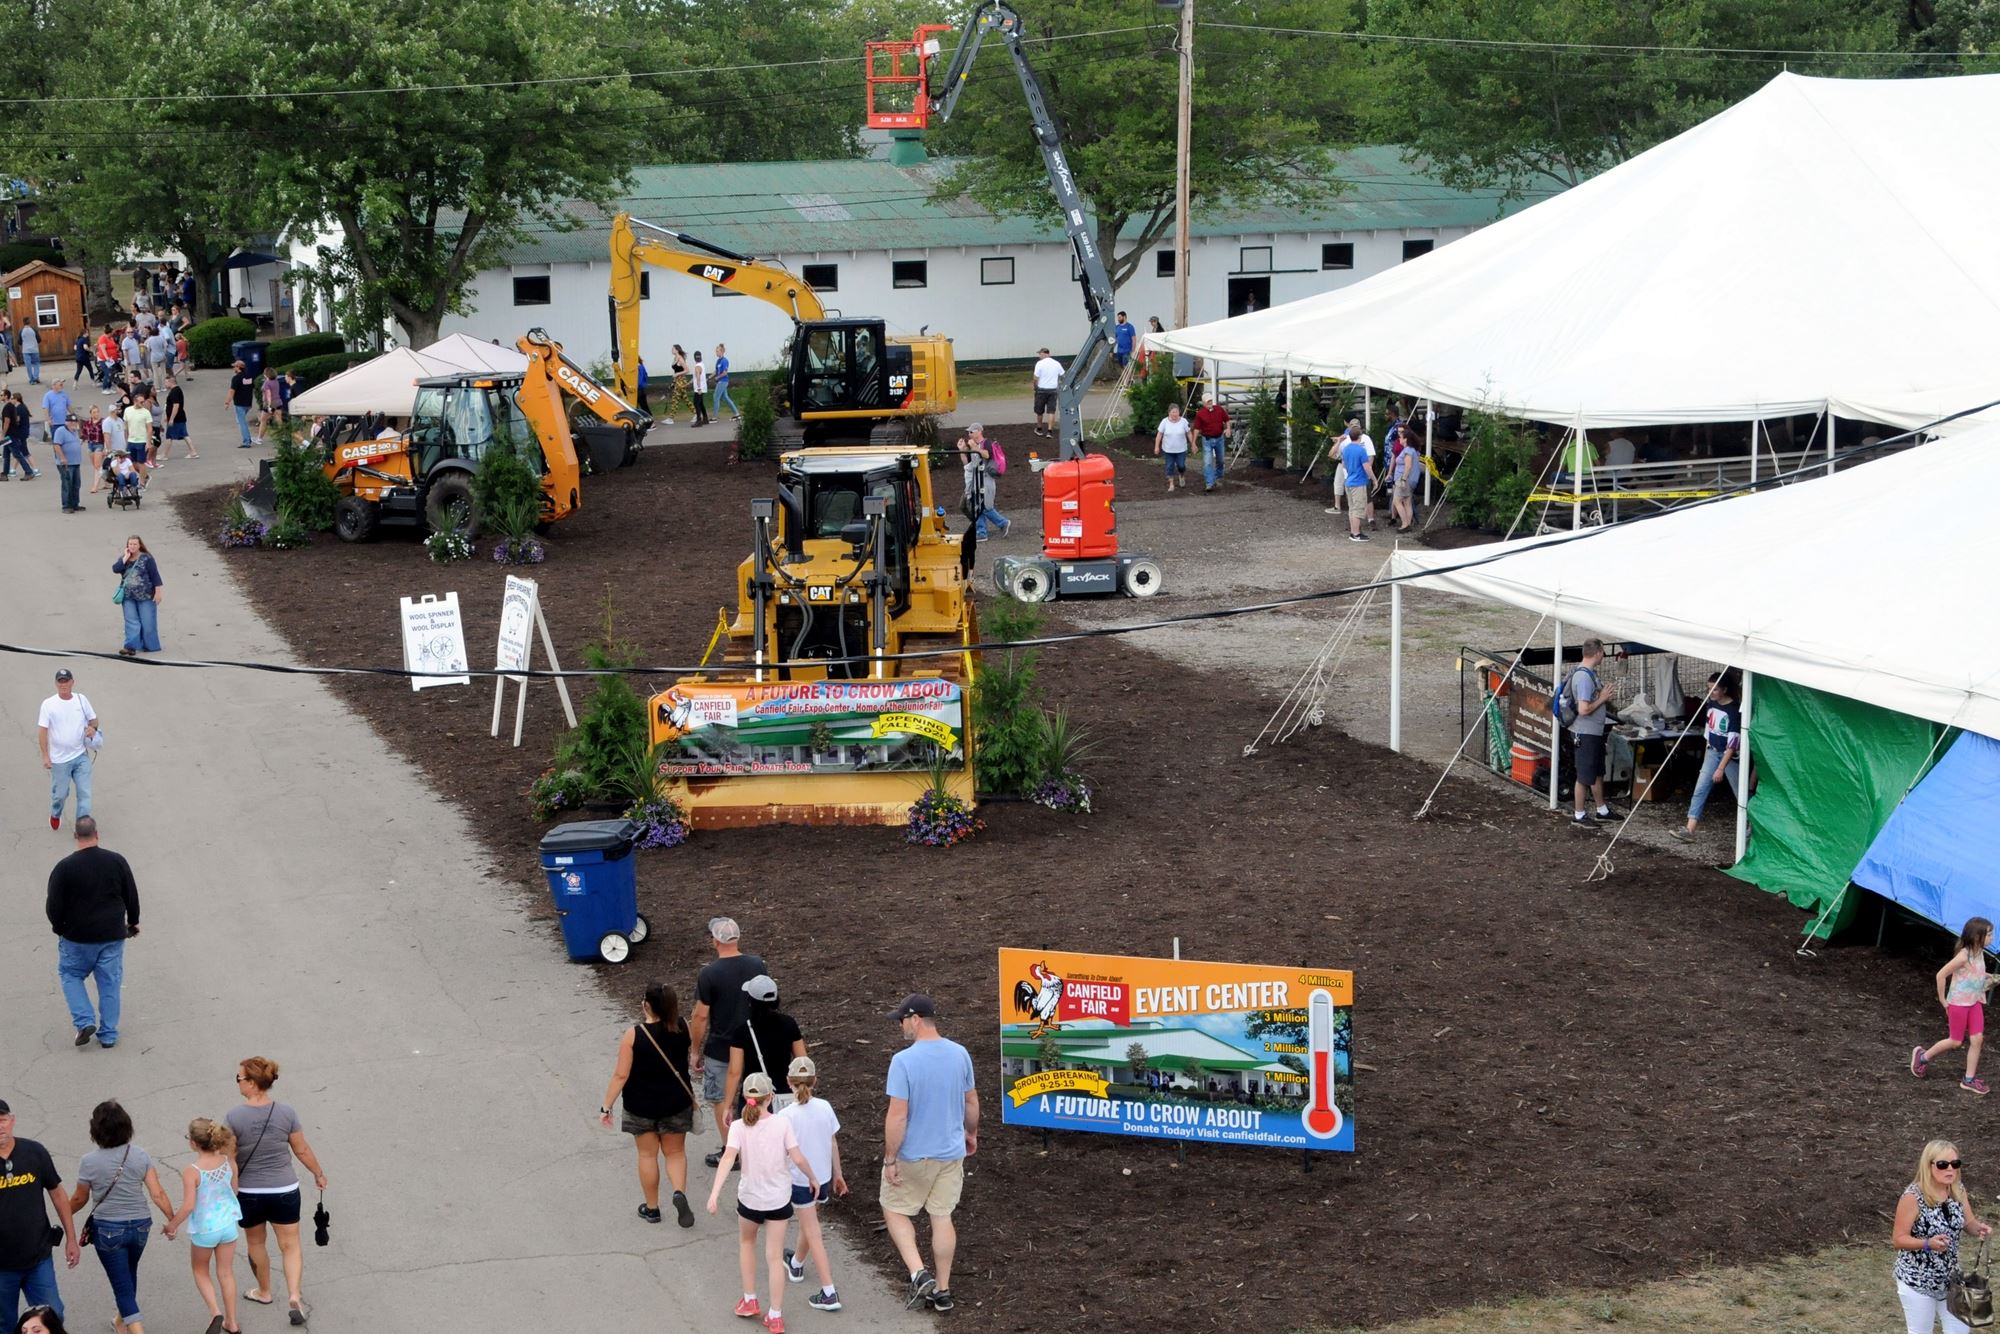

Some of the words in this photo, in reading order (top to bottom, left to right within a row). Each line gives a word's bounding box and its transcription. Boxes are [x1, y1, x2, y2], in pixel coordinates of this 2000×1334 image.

[1053, 151, 1073, 197] SKYJACK
[703, 265, 725, 281] CAT
[557, 366, 601, 403] CASE
[889, 375, 908, 388] CAT
[342, 444, 377, 459] CASE
[1067, 572, 1110, 582] SKYJACK
[810, 586, 832, 600] CAT
[409, 613, 427, 621] WOOL
[428, 609, 455, 619] SPINNER
[411, 624, 430, 632] WOOL
[430, 621, 455, 630] DISPLAY
[745, 685, 756, 701] A
[761, 685, 821, 700] FUTURE
[825, 684, 844, 700] TO
[848, 683, 897, 699] CROW
[900, 682, 953, 698] ABOUT
[694, 701, 731, 711] CANFIELD
[755, 703, 786, 714] Canfield
[856, 703, 877, 712] Home
[880, 702, 889, 712] of
[889, 702, 901, 711] the
[903, 701, 927, 711] Junior
[929, 701, 944, 711] Fair
[704, 711, 722, 721] FAIR
[886, 715, 944, 732] OPENING
[881, 722, 911, 730] FALL
[915, 725, 947, 741] 2020
[724, 761, 744, 773] FAIR
[1299, 975, 1306, 985] 4
[1308, 975, 1344, 988] Million
[1067, 983, 1121, 1001] CANFIELD
[1135, 985, 1201, 1014] EVENT
[1205, 981, 1289, 1011] CENTER
[1081, 999, 1108, 1015] FAIR
[1264, 1012, 1271, 1022] 3
[1273, 1012, 1309, 1023] Million
[1264, 1042, 1271, 1052] 2
[1273, 1042, 1308, 1054] Million
[1016, 1072, 1051, 1091] GROUND
[1053, 1070, 1099, 1083] BREAKING
[1040, 1079, 1075, 1091] 9-25-19
[1265, 1072, 1271, 1081] 1
[1273, 1072, 1309, 1084] Million
[1039, 1094, 1051, 1113] A
[1055, 1095, 1121, 1119] FUTURE
[1123, 1101, 1146, 1121] TO
[1150, 1103, 1200, 1125] CROW
[1205, 1107, 1262, 1130] ABOUT
[1123, 1122, 1160, 1134] Donate
[1162, 1125, 1195, 1138] Today!
[1196, 1128, 1220, 1139] Visit
[1222, 1130, 1307, 1144] canfieldfair.com
[0, 1172, 36, 1189] inzer
